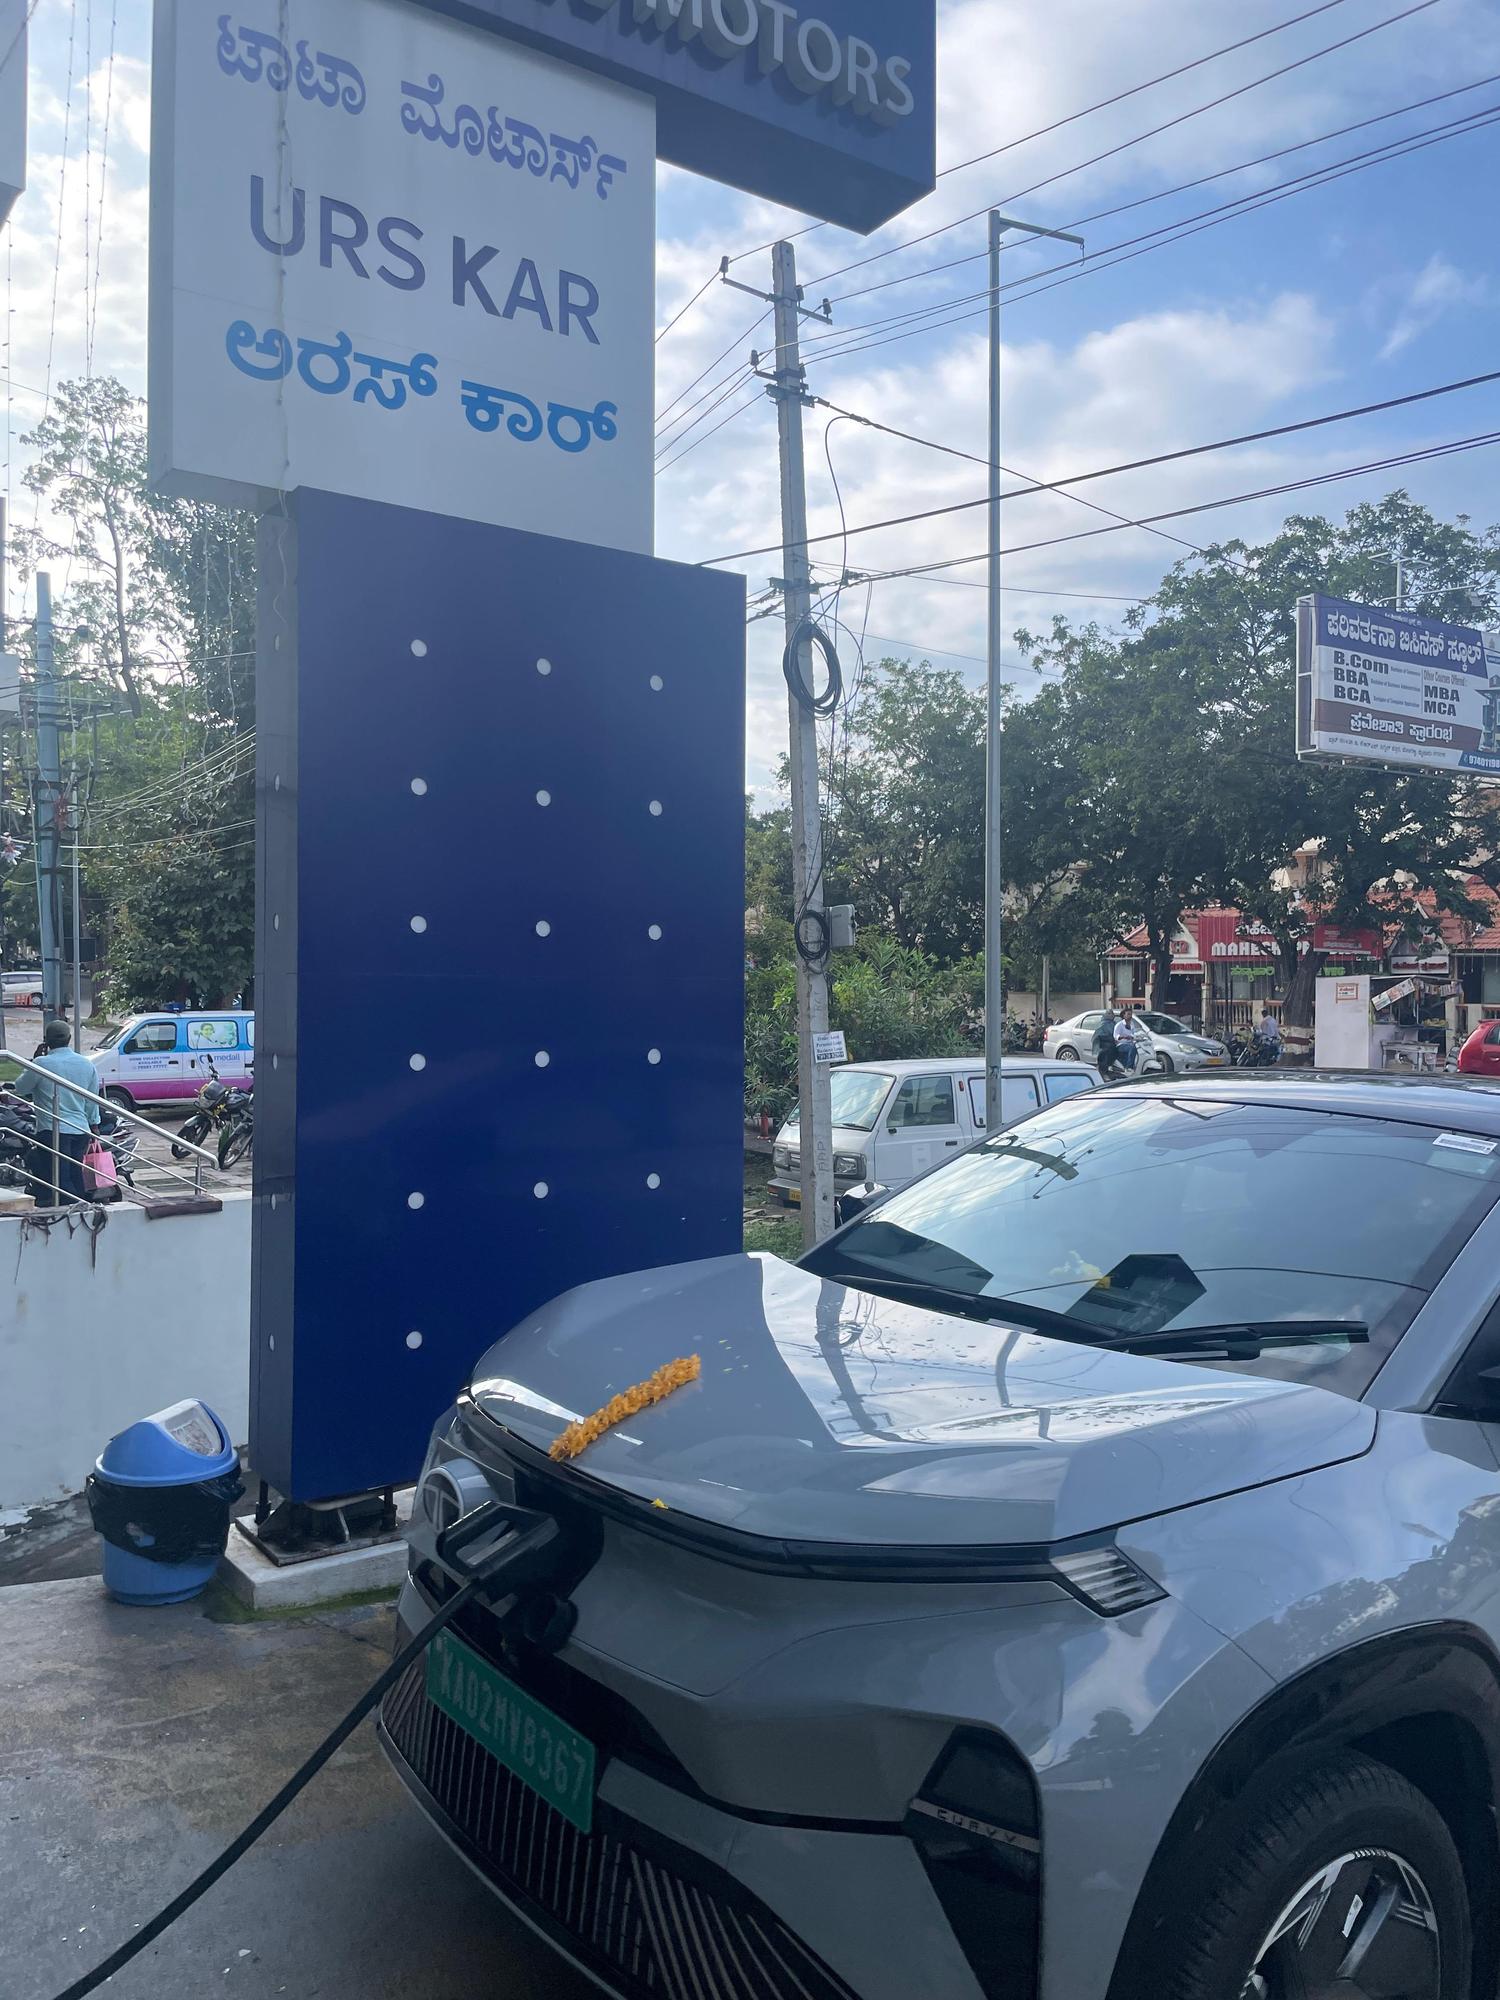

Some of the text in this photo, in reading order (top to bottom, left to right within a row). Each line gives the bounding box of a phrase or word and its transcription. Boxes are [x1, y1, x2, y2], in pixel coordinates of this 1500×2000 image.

[216, 14, 367, 115] ಟಾಟಾ
[250, 174, 601, 345] URS KAR
[225, 320, 618, 453] ಅರಸ್ ಕಾರ್
[1327, 609, 1396, 649] ಪರಿವರ್ತನಾ
[1333, 650, 1389, 675] B.Com
[1333, 667, 1369, 687] BBA
[1333, 685, 1372, 704] BCA
[1424, 685, 1460, 702] MBA
[1424, 700, 1457, 717] MCA
[1350, 712, 1453, 743] ಪ್ರವೇಶಾತಿ ಪ್ರಾರಂಭ
[213, 1053, 240, 1061] medall
